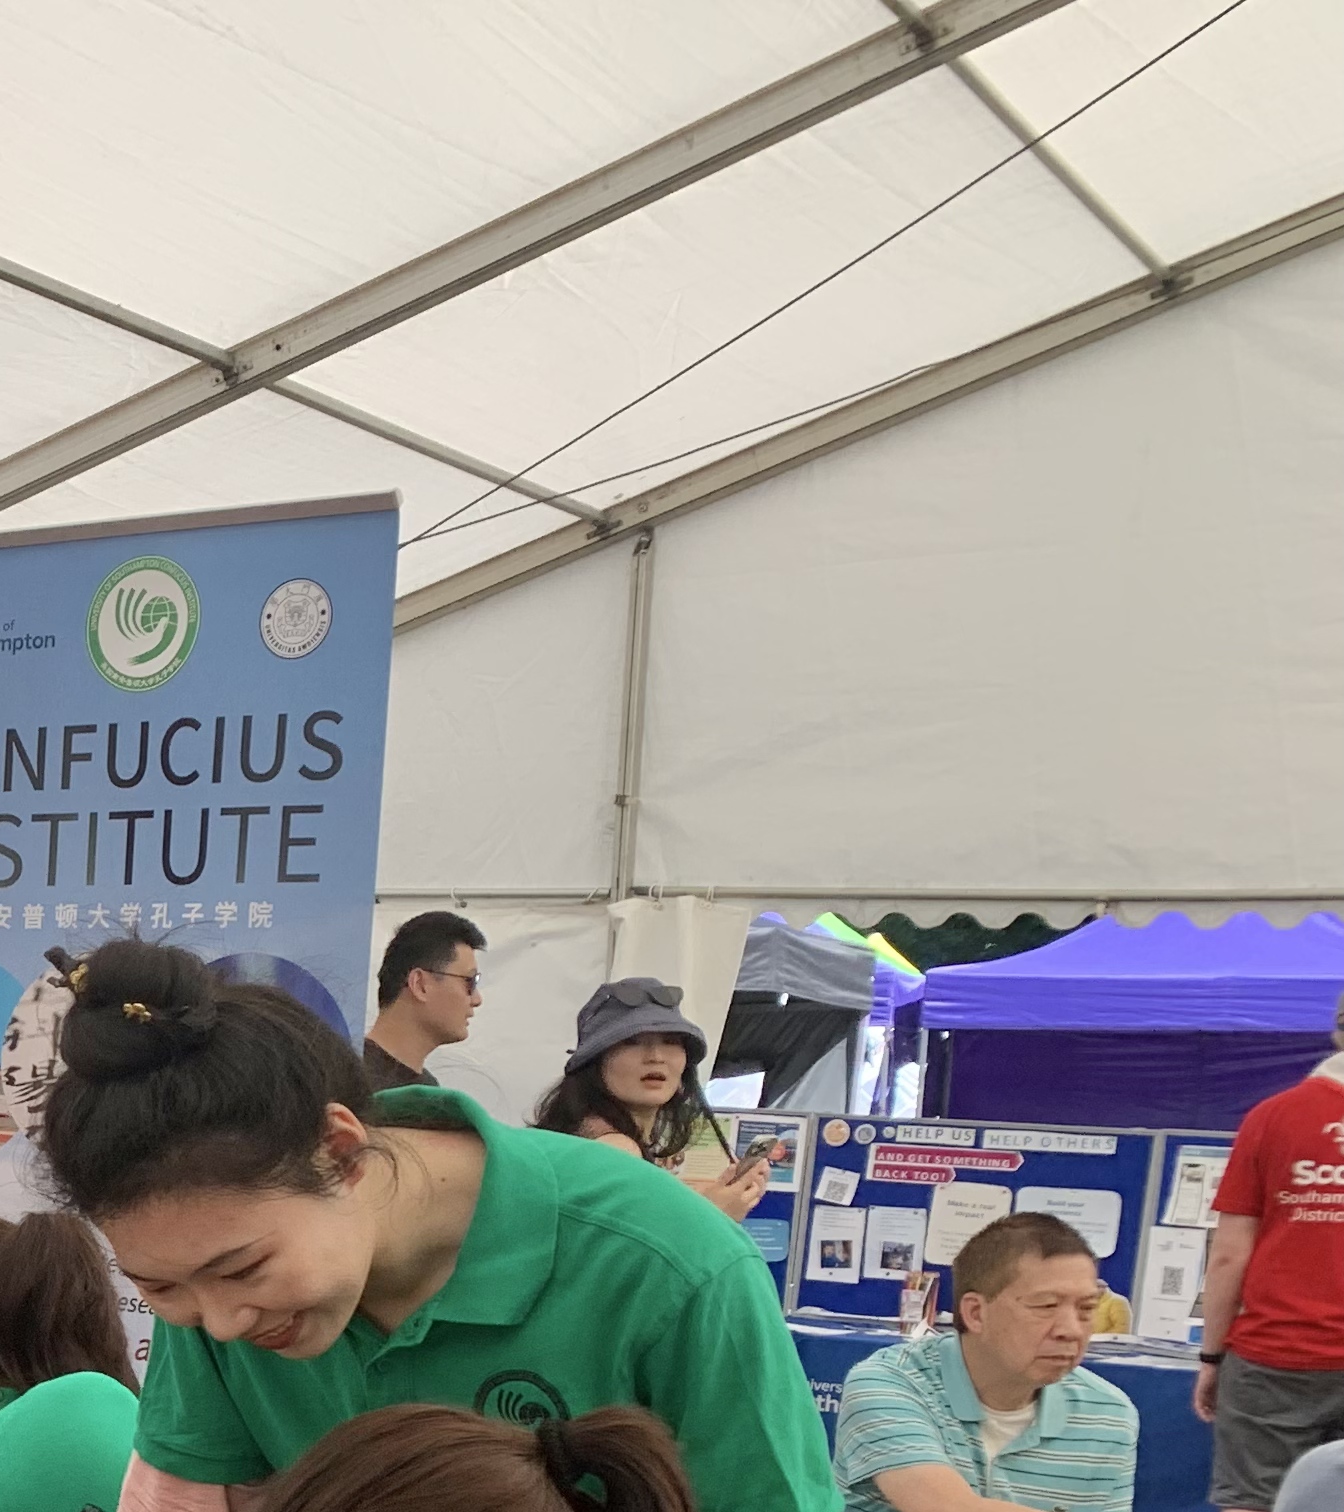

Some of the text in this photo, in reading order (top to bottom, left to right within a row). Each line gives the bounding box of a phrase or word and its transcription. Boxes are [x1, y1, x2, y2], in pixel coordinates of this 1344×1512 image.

[3, 619, 15, 631] of
[902, 1127, 1115, 1151] HELP US HELP OTHERS
[877, 1152, 1011, 1168] AND GET SOMETHING
[875, 1169, 946, 1182] BACK TOO!
